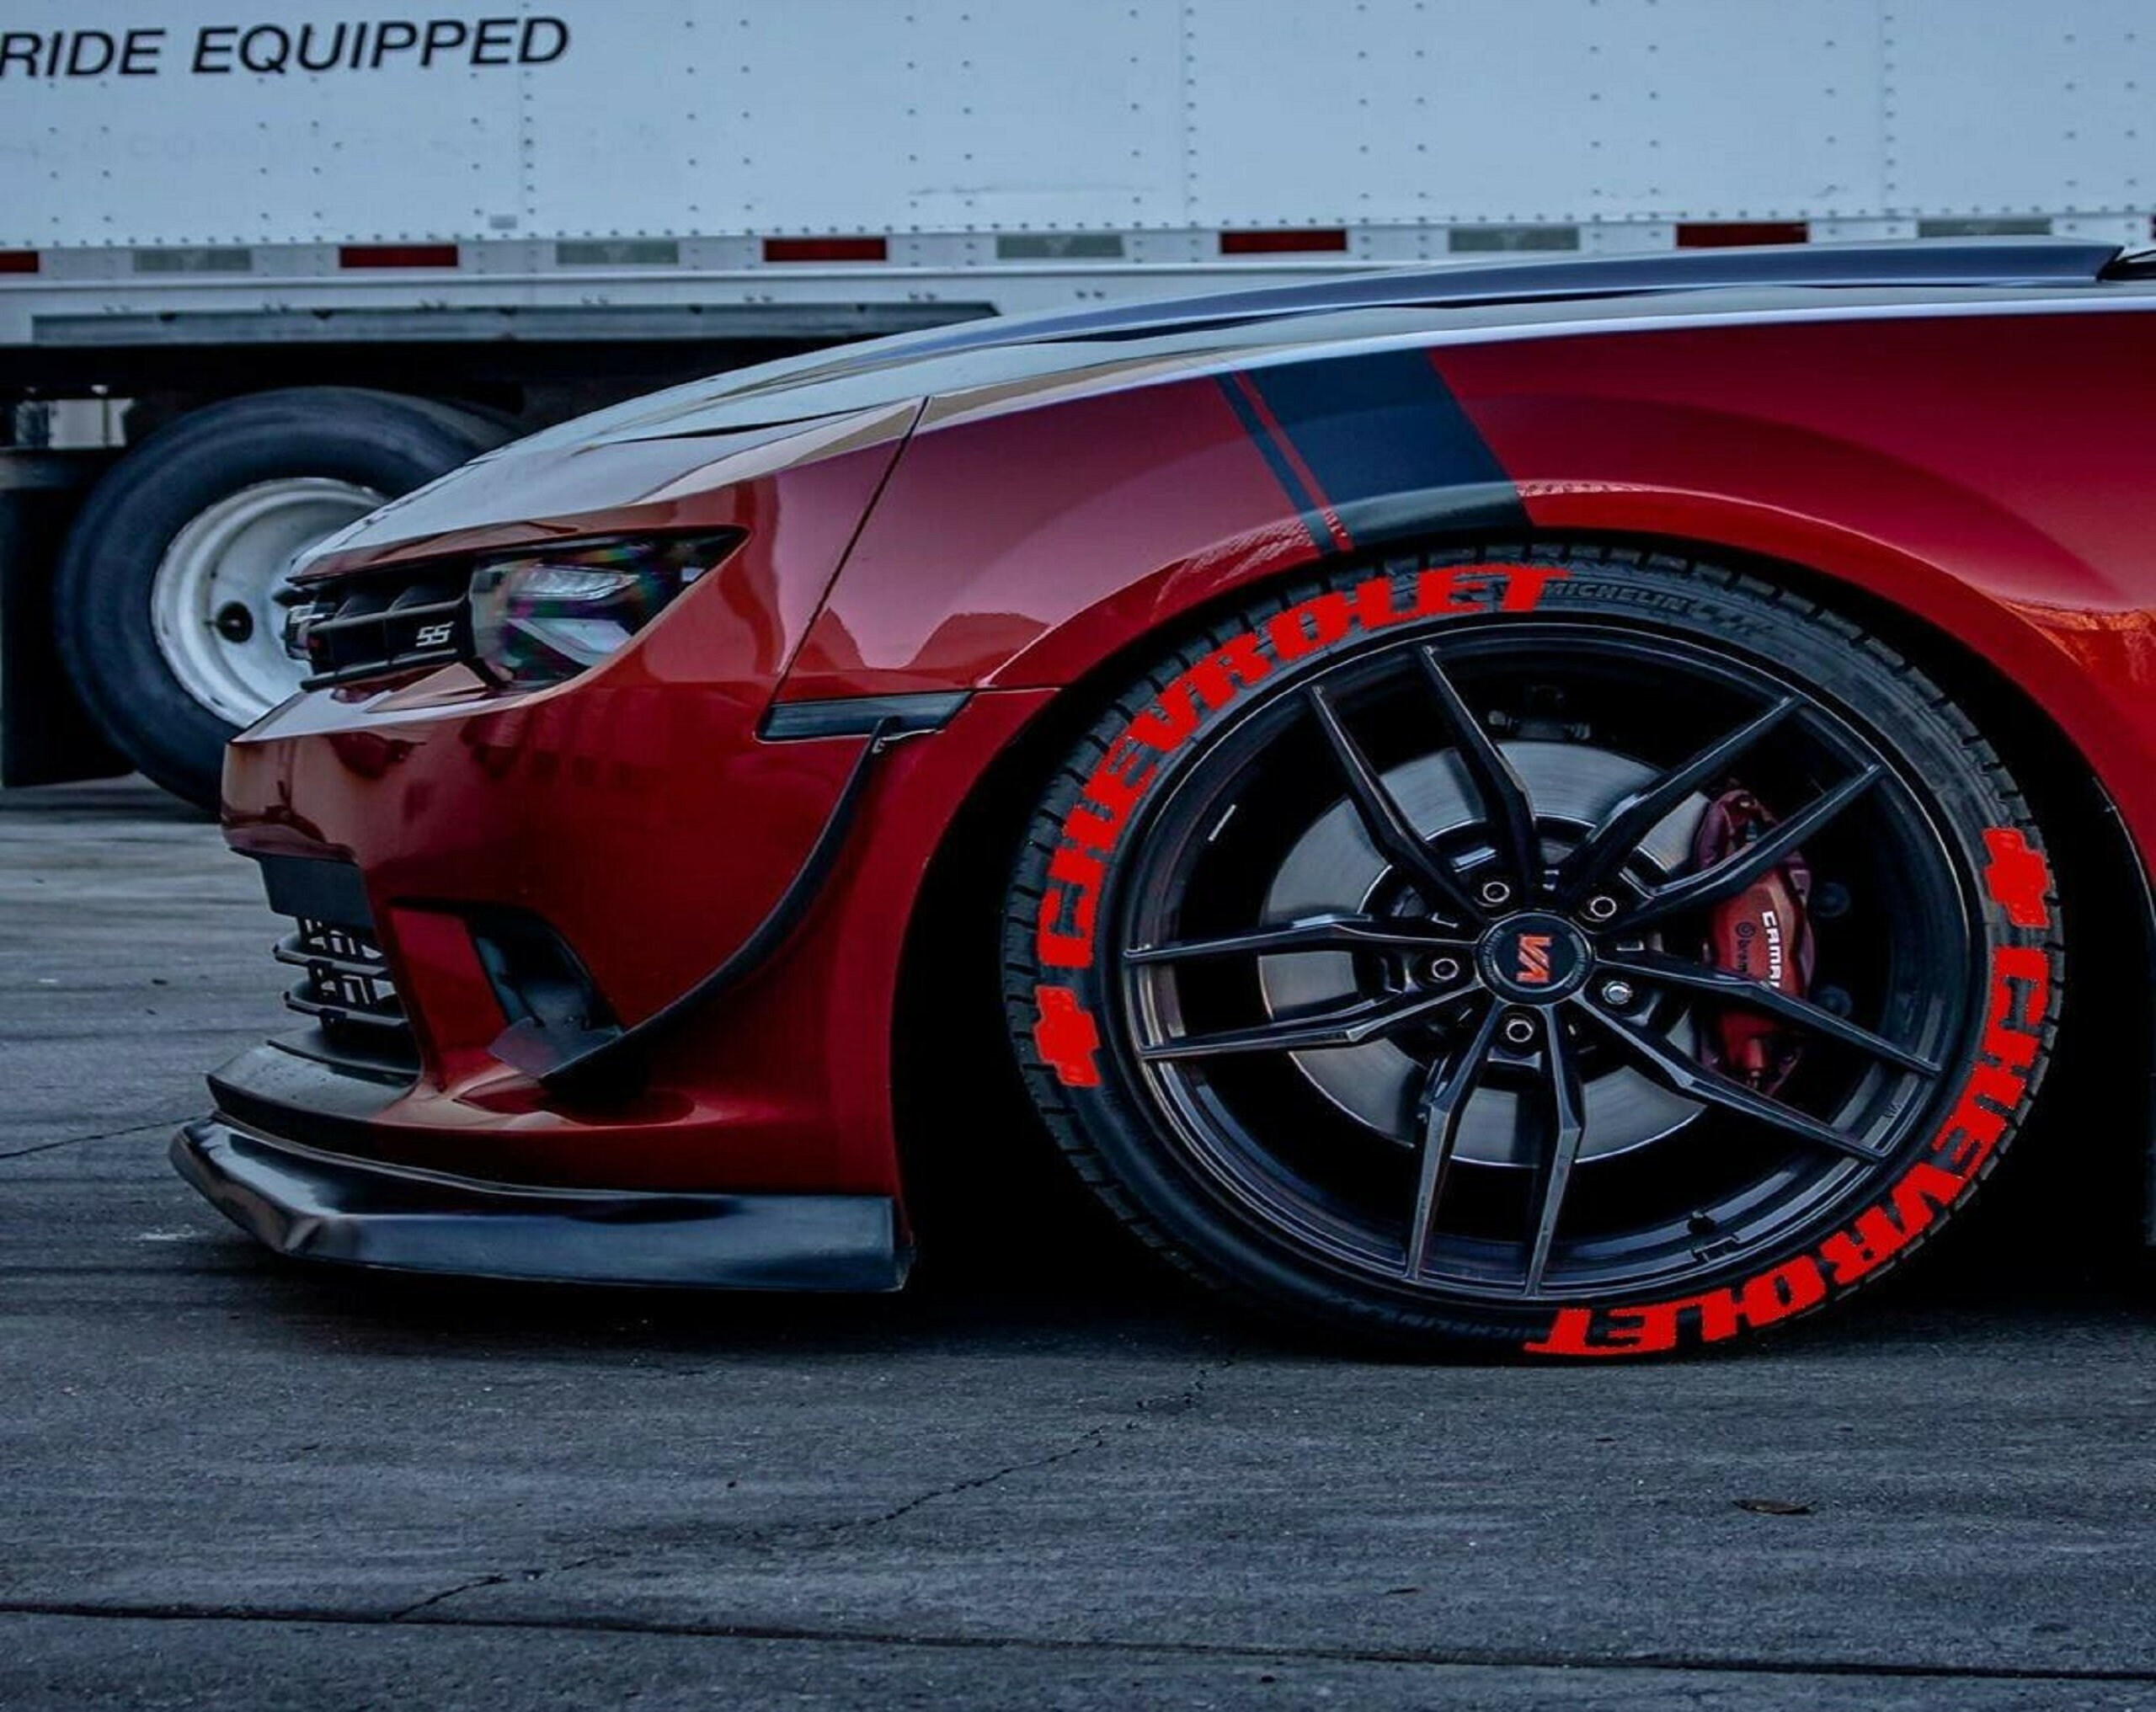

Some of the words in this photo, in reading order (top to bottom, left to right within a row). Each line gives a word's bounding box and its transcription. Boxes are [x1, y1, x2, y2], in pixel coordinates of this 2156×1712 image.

[0, 29, 166, 77] RIDE
[191, 17, 570, 75] EQUIPPED
[1545, 582, 1689, 611] MICHELIN
[415, 621, 455, 647] SS
[1038, 563, 1571, 967] CHEVROLET
[1737, 938, 1749, 973] brem
[1523, 945, 2052, 1357] CHEVROLET
